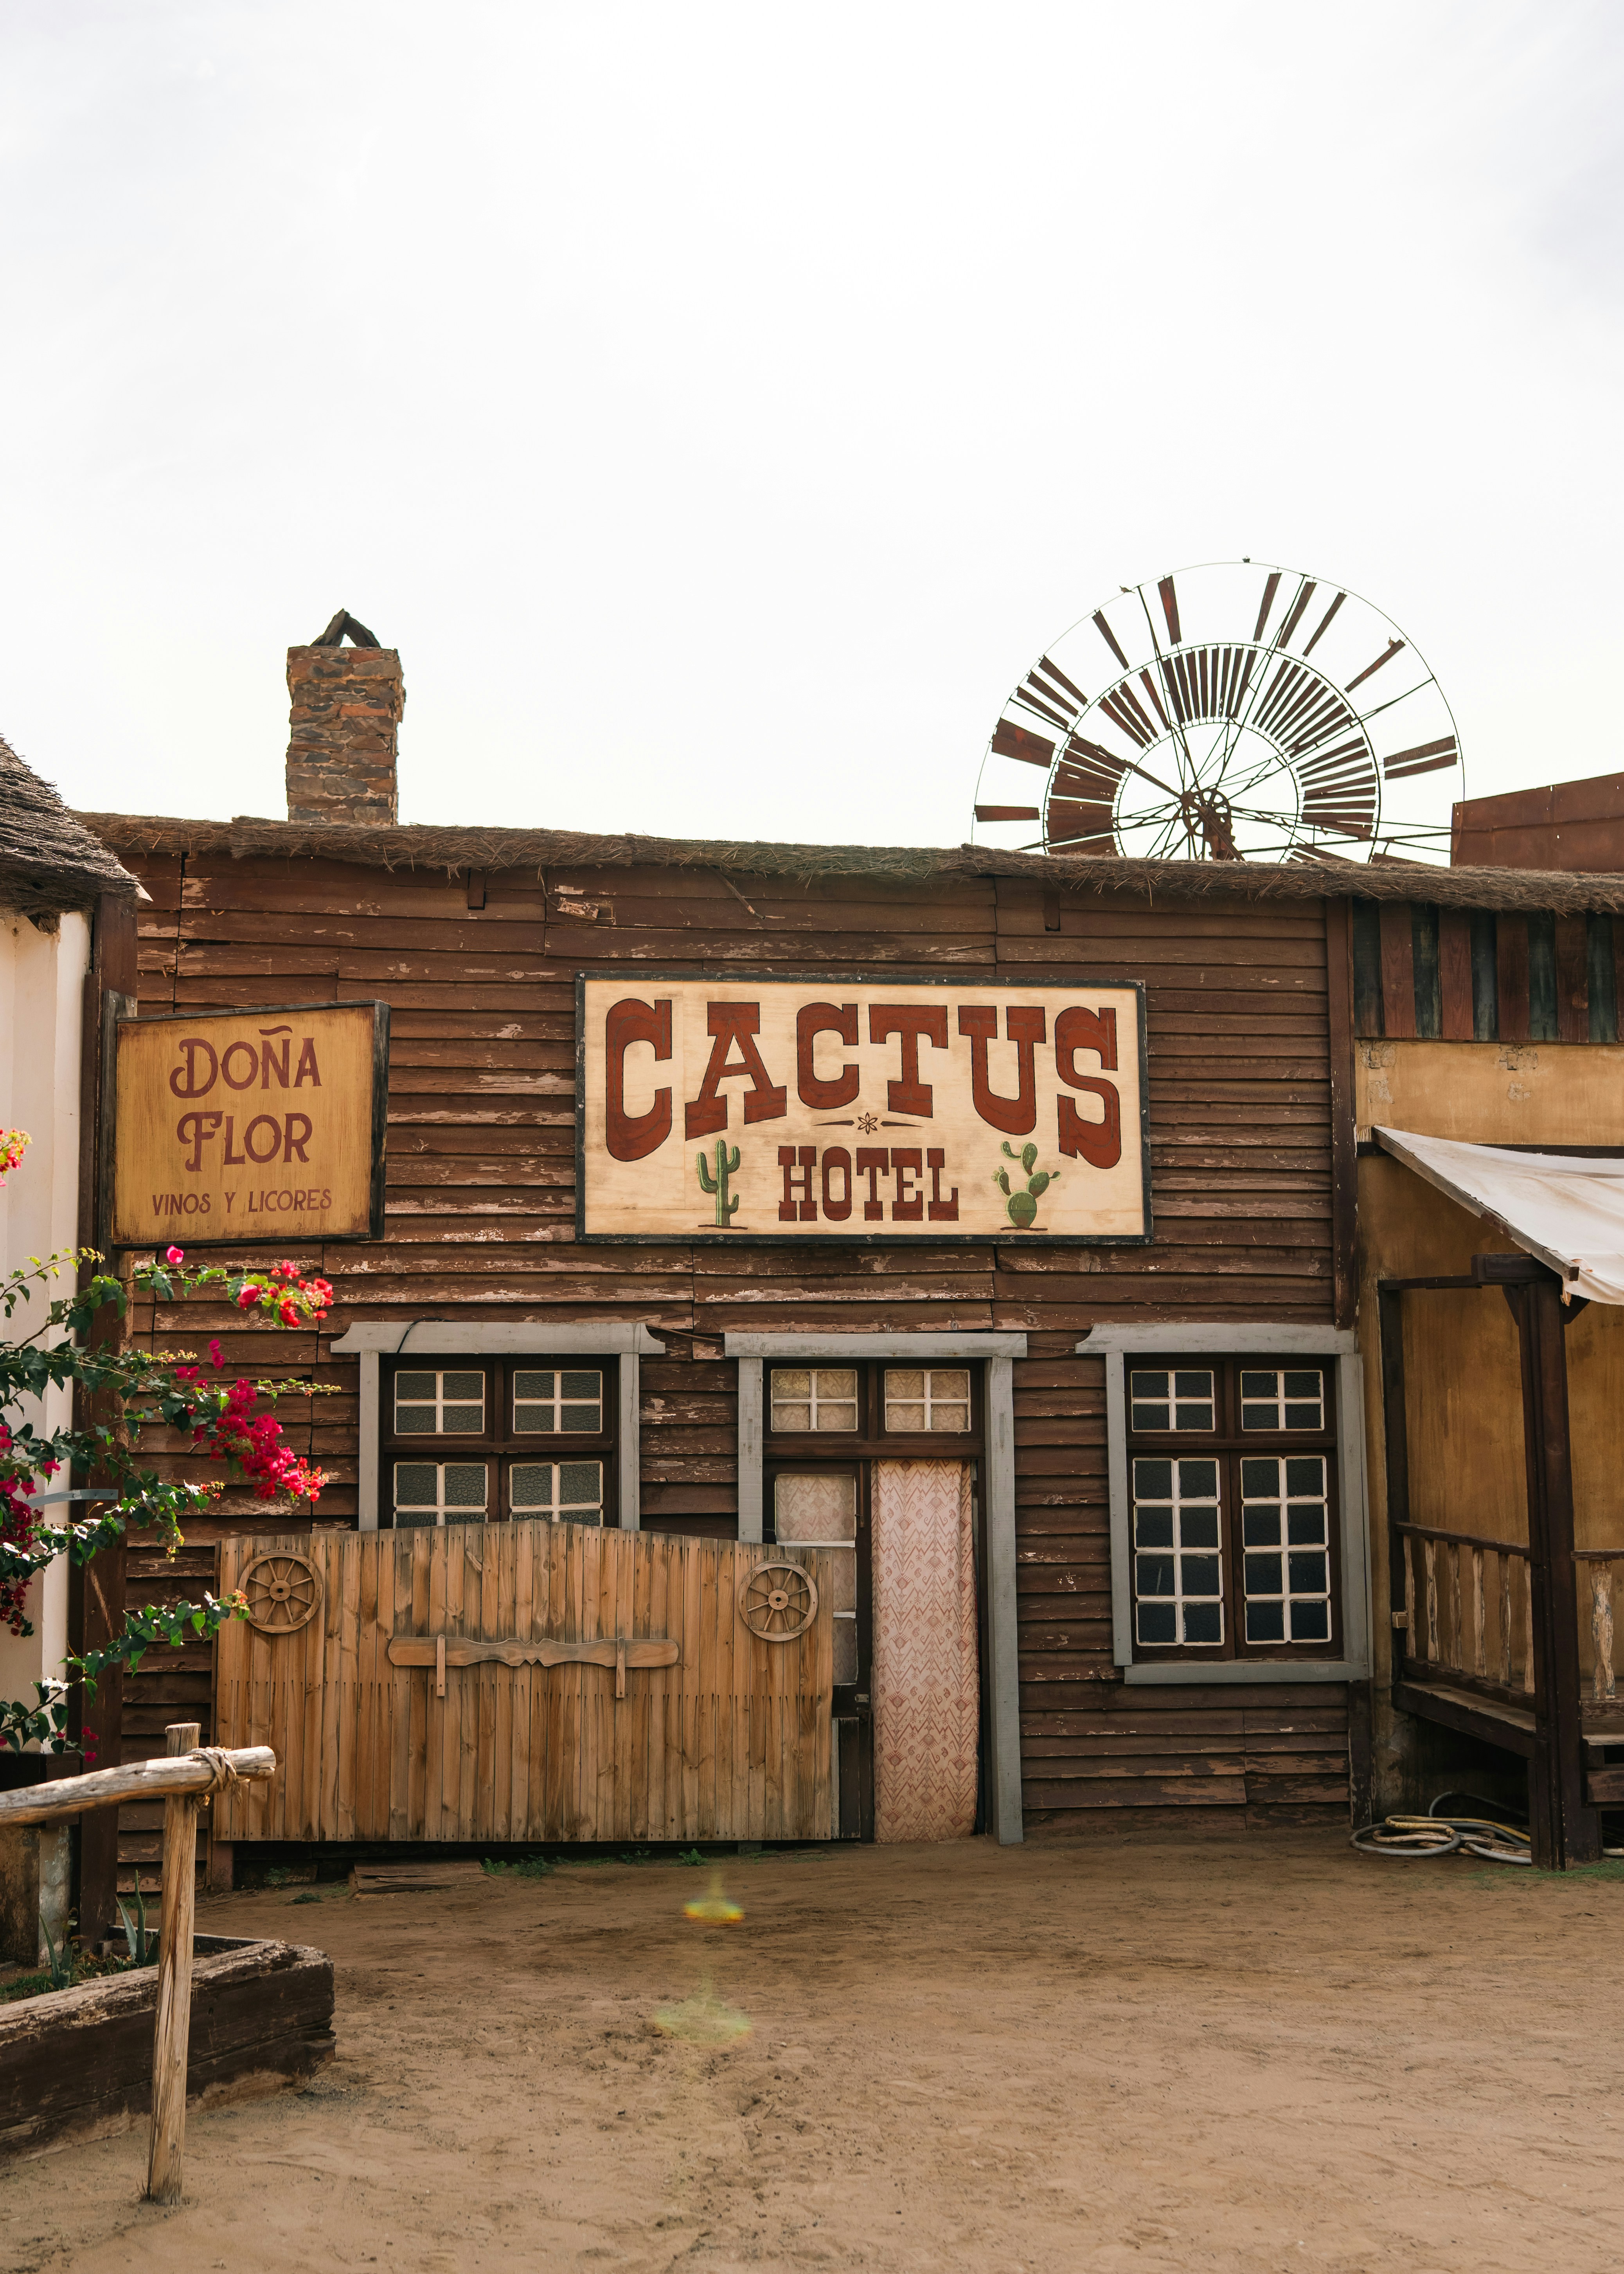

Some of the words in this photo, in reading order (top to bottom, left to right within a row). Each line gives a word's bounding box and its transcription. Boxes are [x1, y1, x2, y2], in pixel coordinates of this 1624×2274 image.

[169, 1025, 322, 1099] DOÑA
[606, 998, 1122, 1170] CACTUS
[176, 1111, 313, 1172] FLOR
[152, 1193, 211, 1216] VINOS
[224, 1192, 236, 1213] Y
[248, 1188, 332, 1212] LICORES
[778, 1145, 959, 1222] HOTEL
